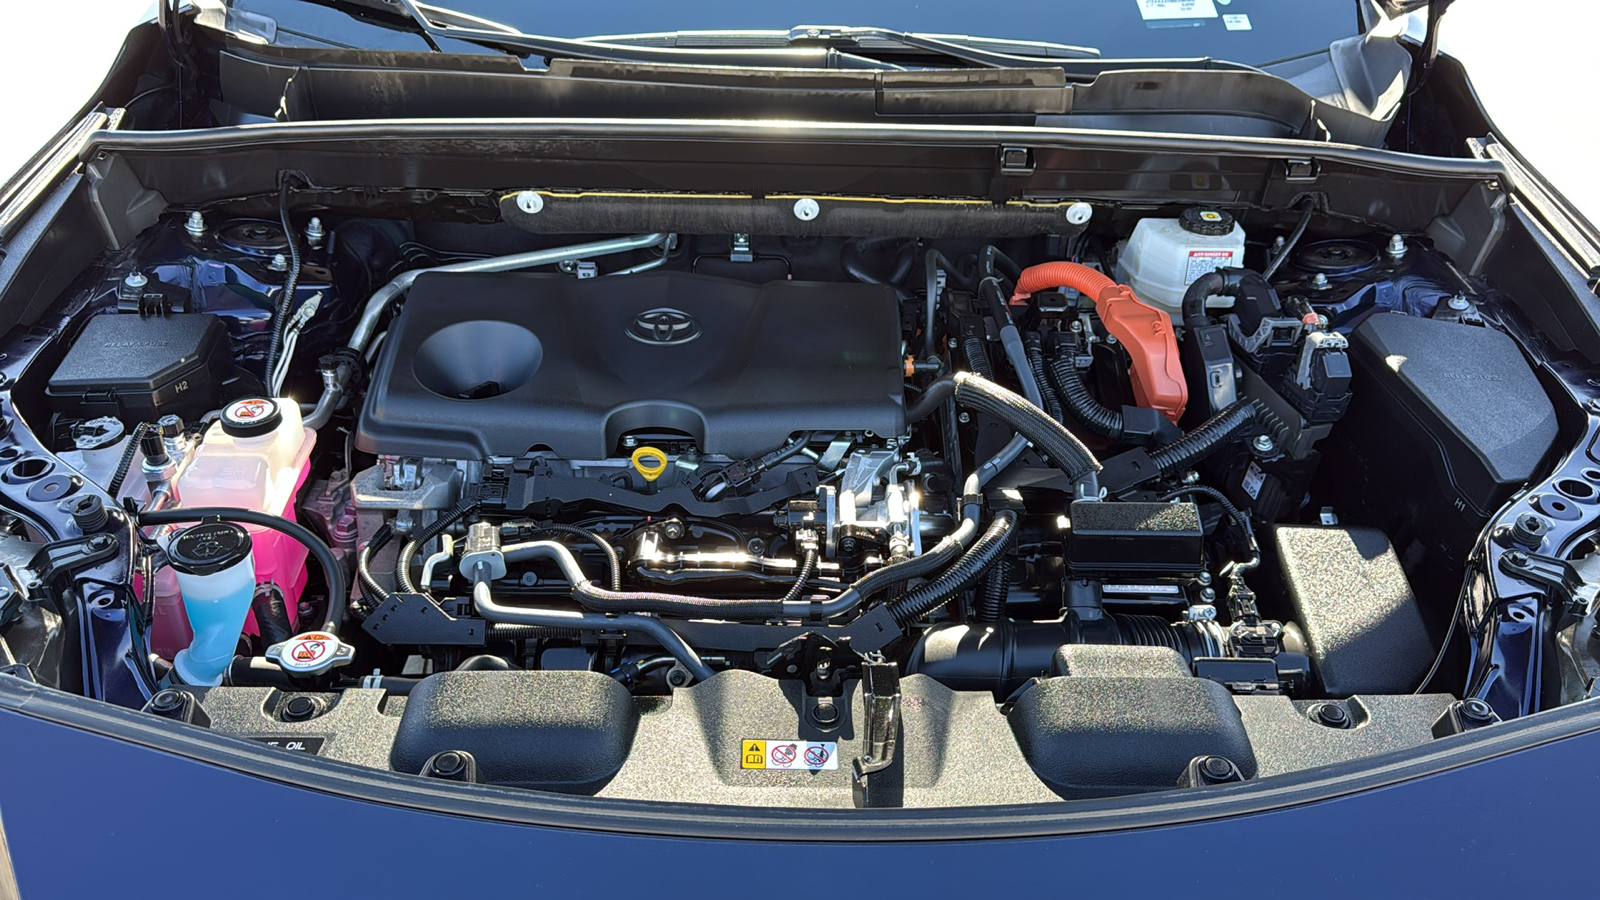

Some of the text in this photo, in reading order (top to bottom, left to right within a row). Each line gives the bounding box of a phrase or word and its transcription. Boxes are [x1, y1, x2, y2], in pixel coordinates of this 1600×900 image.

[175, 381, 189, 393] H2
[1454, 497, 1466, 511] H1
[285, 741, 306, 750] OIL
